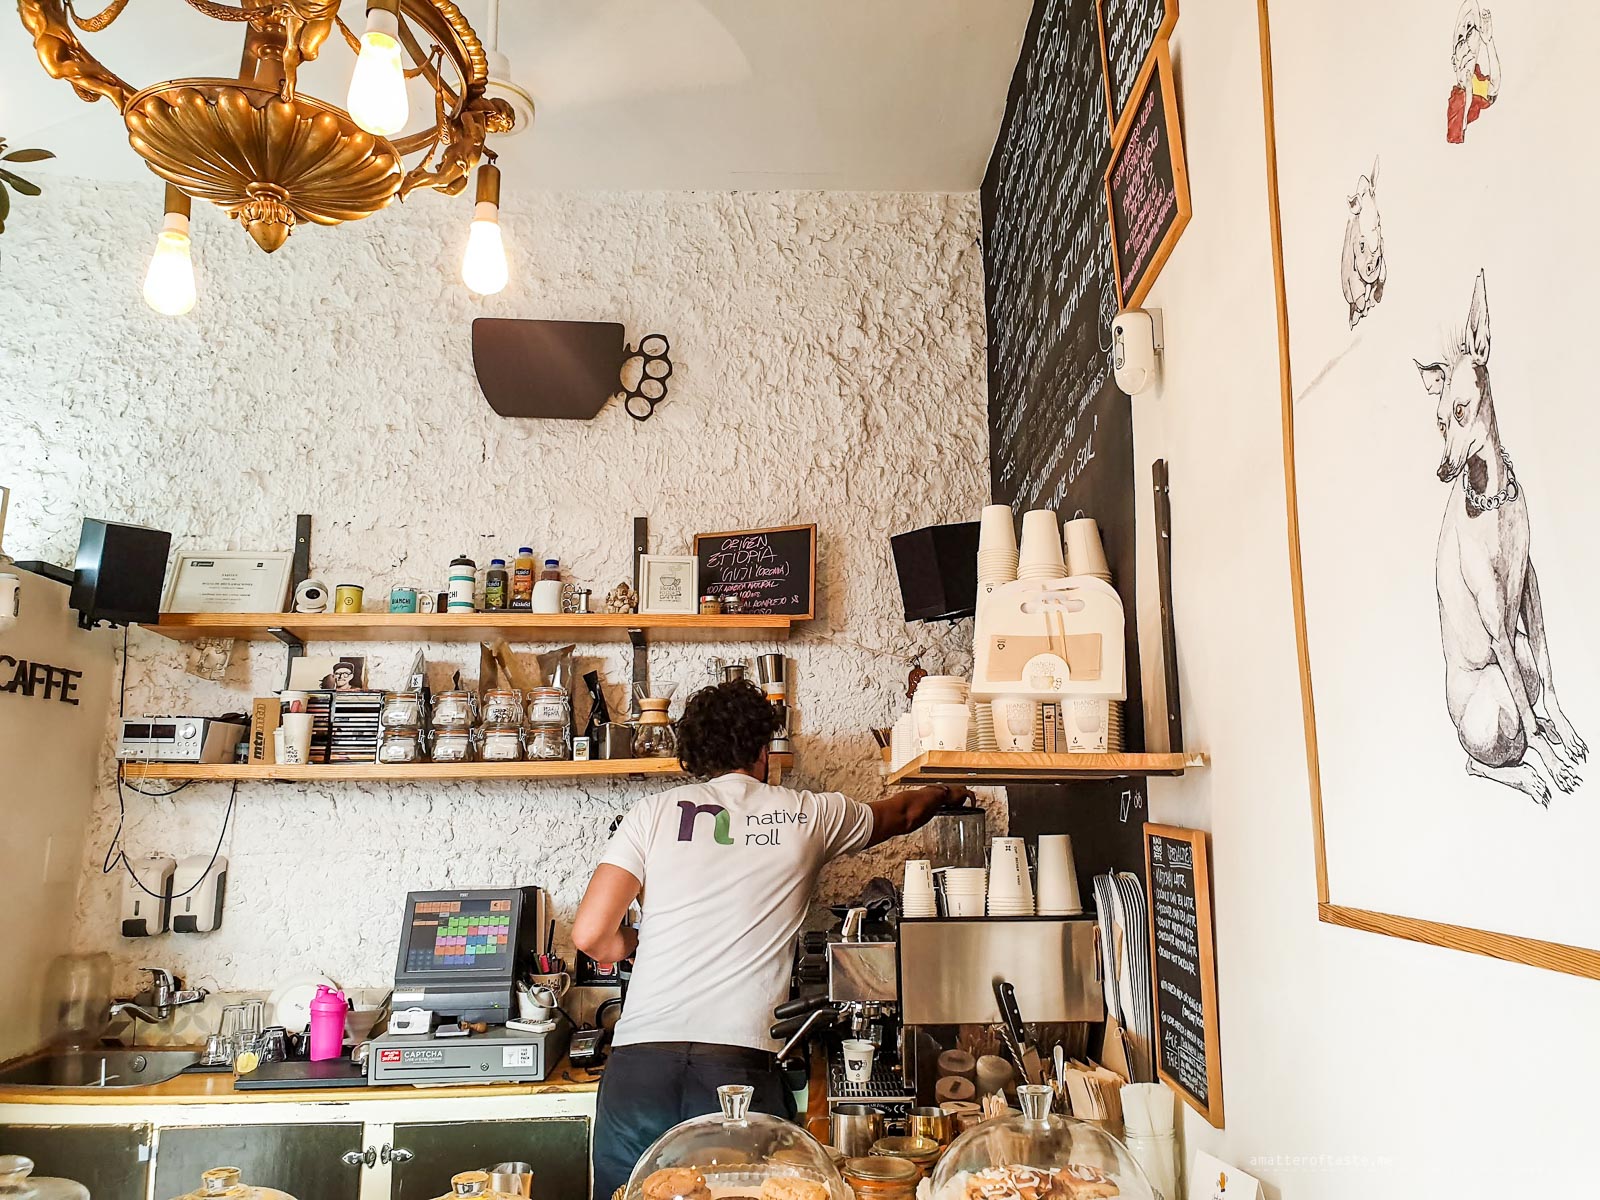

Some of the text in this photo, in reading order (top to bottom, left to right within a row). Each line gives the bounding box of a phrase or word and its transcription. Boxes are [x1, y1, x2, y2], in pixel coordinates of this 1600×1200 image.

[0, 654, 83, 706] CAFFE
[746, 809, 808, 827] native
[745, 828, 781, 847] roll
[404, 1050, 443, 1058] CAPTCHA
